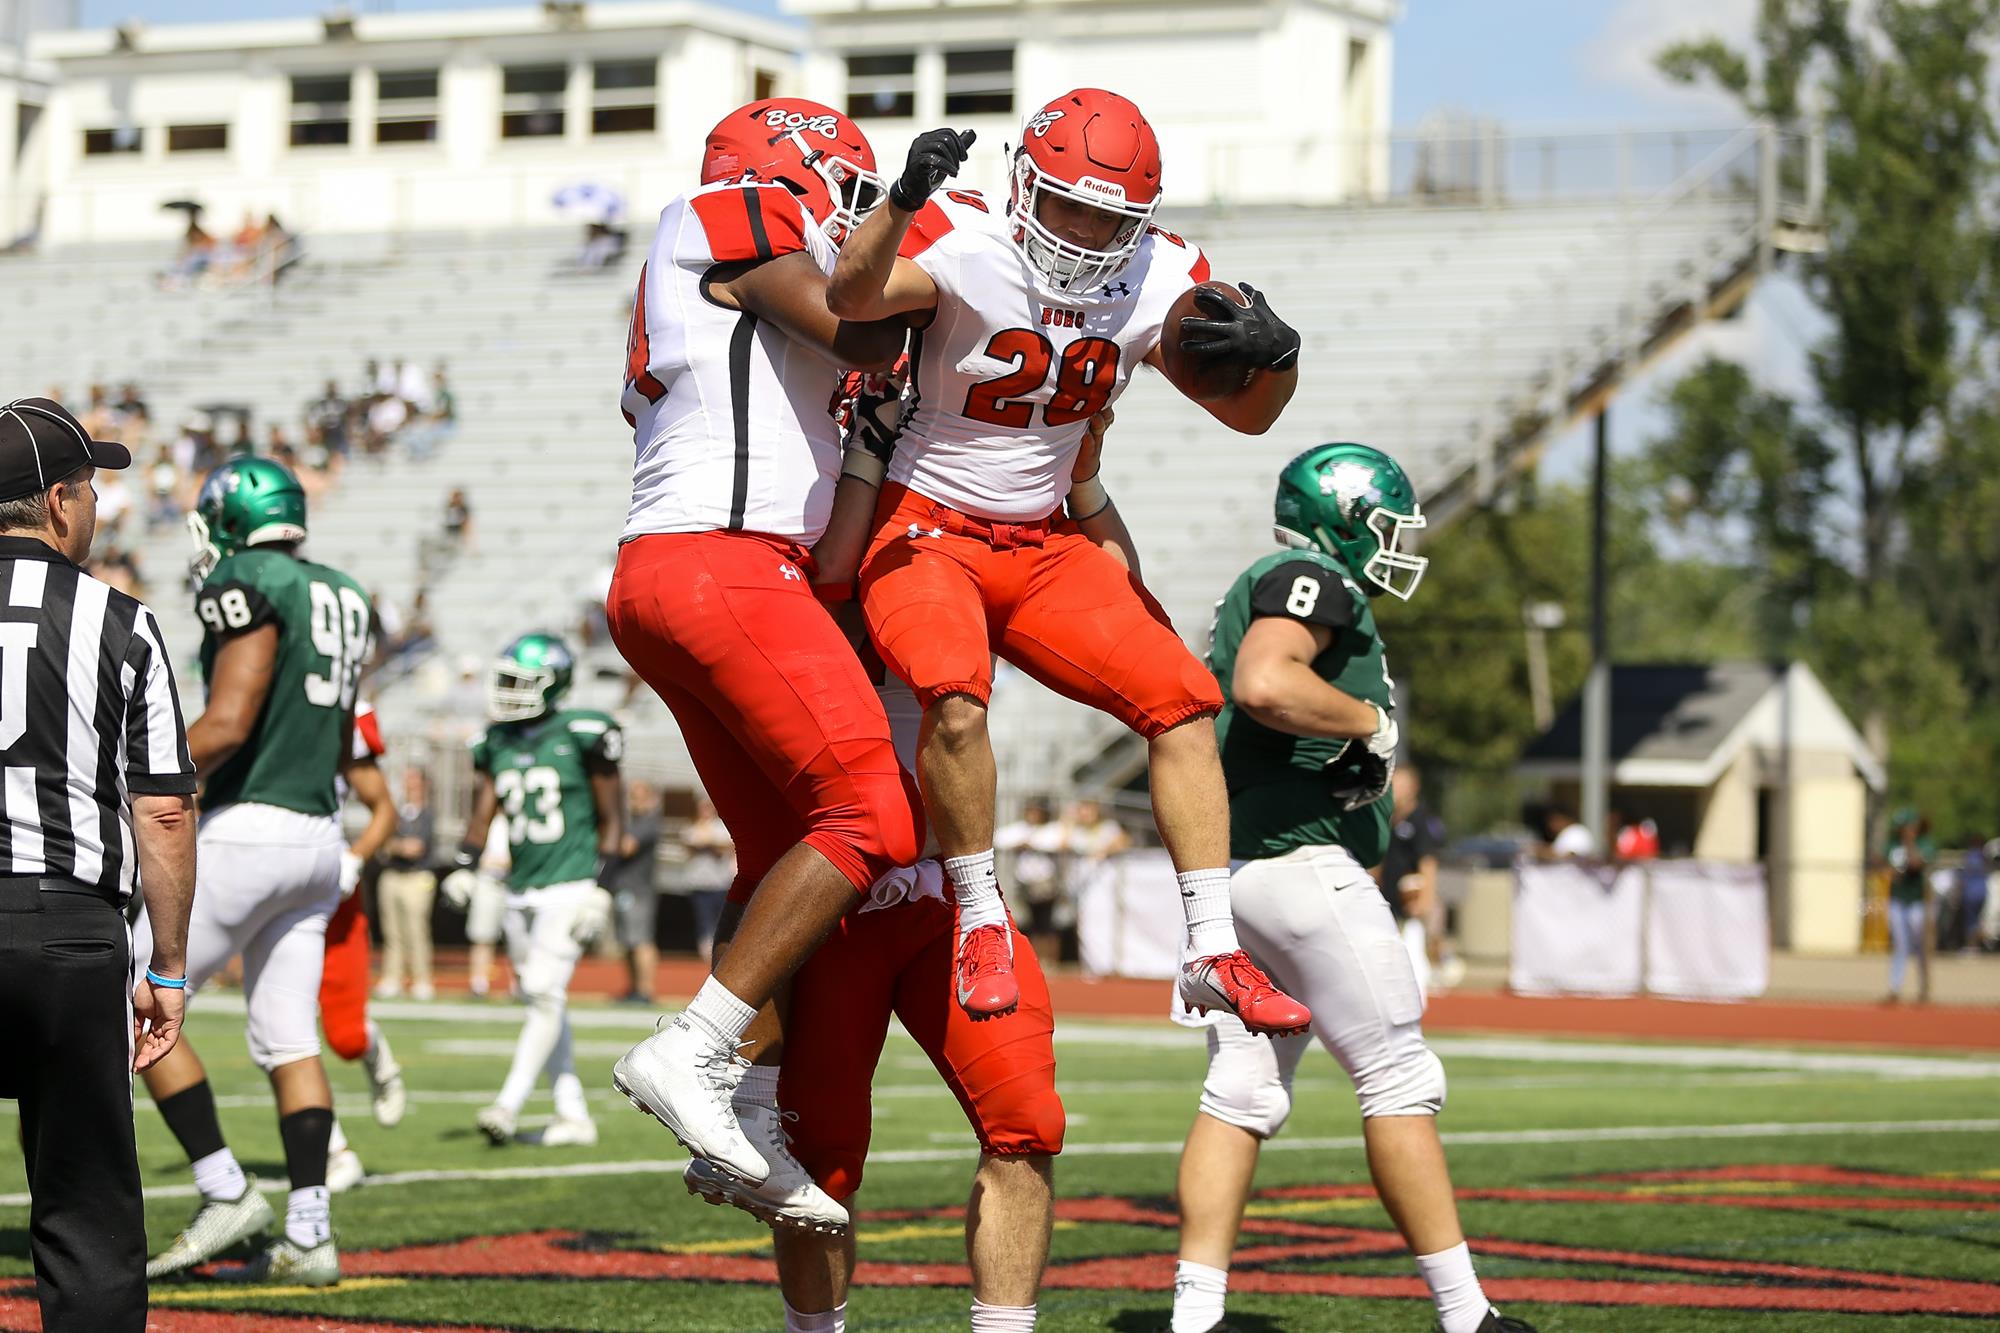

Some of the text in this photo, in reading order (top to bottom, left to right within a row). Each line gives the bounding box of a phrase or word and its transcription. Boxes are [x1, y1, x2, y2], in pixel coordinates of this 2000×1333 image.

[1084, 179, 1122, 198] Riddell
[1041, 307, 1085, 329] BORO
[962, 328, 1121, 429] 28
[200, 588, 252, 633] 98
[1286, 575, 1320, 617] 8
[305, 581, 371, 710] 98
